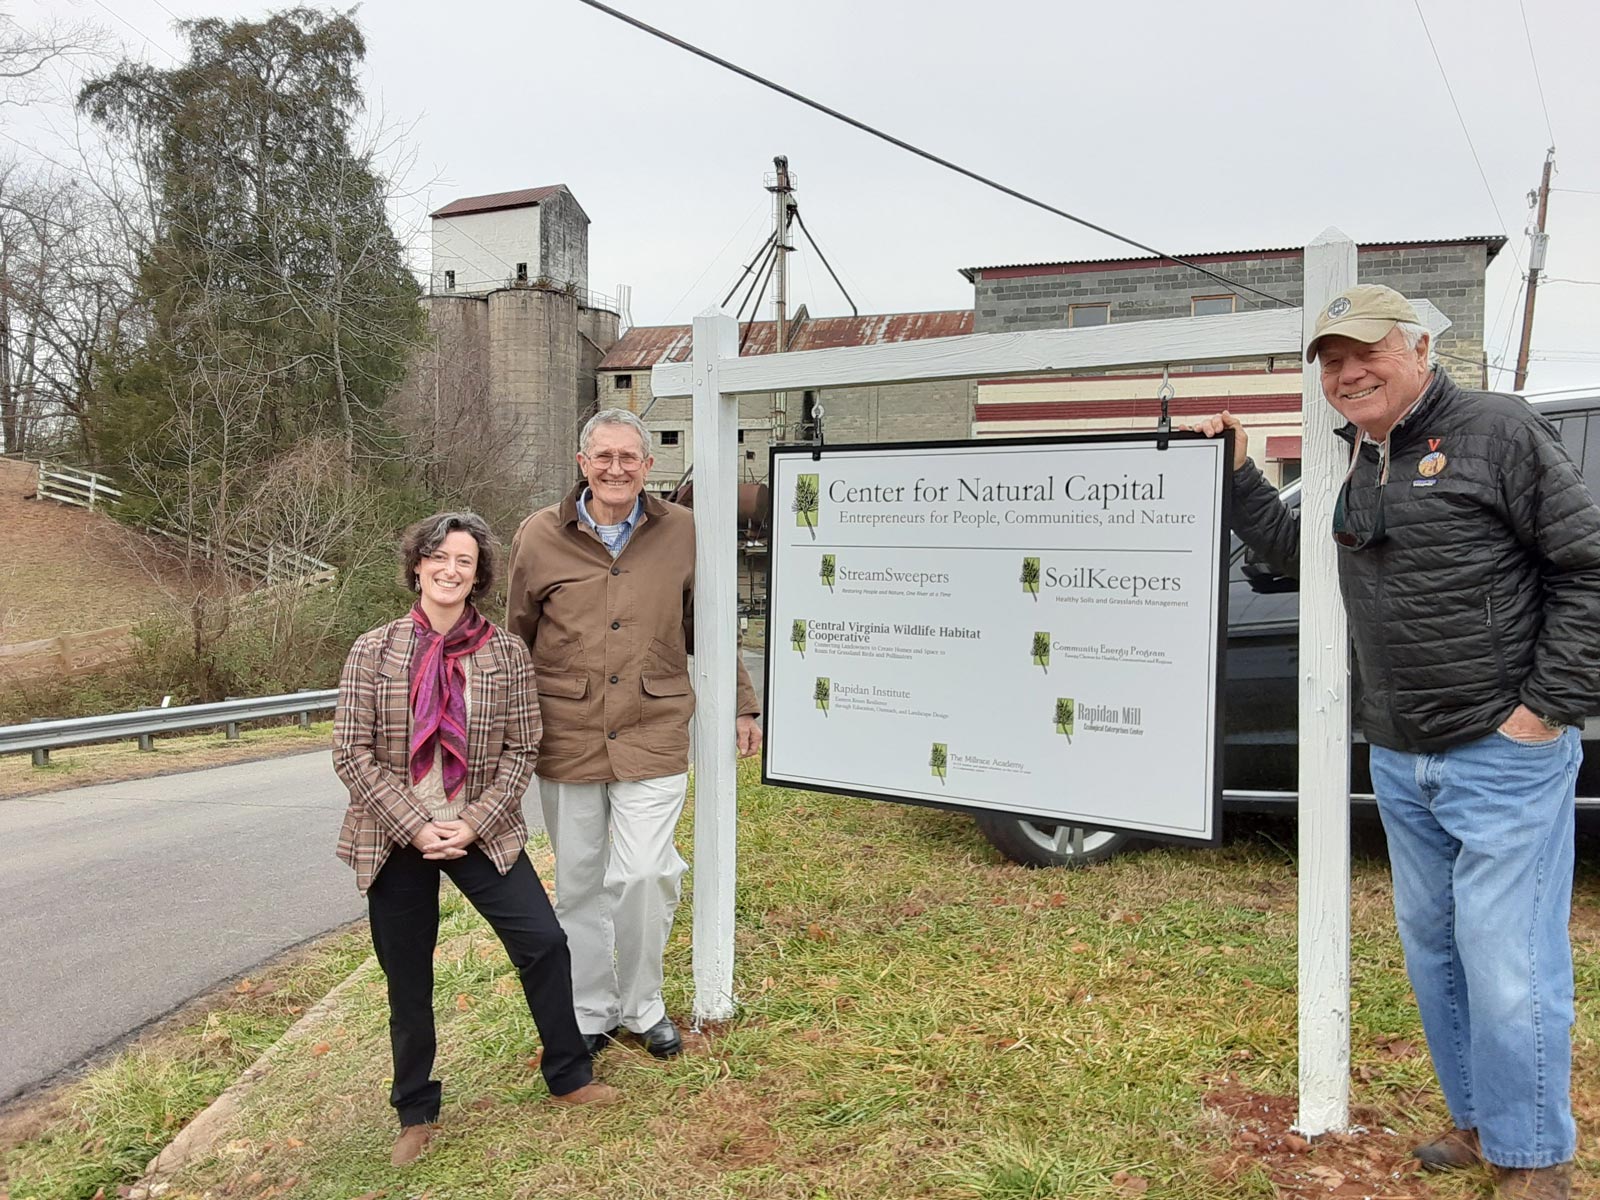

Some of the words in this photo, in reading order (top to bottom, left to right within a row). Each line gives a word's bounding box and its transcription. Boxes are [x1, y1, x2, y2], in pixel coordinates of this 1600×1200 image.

[828, 479, 905, 503] Center
[912, 477, 949, 503] for
[956, 475, 1054, 503] Natural
[1064, 473, 1165, 509] Capital
[839, 510, 925, 527] Entrepreneurs
[929, 510, 949, 524] for
[952, 510, 1000, 528] People,
[1004, 509, 1103, 527] Communities,
[1107, 509, 1135, 525] and
[1140, 509, 1196, 525] Nature
[839, 566, 949, 587] StreamSweepers
[1045, 566, 1182, 597] SoilKeepers
[1055, 596, 1079, 605] Healthy
[1080, 596, 1094, 604] Soils
[1109, 597, 1143, 606] Grasslands
[1144, 599, 1189, 608] Management
[808, 619, 845, 632] Central
[848, 621, 890, 634] Virginia
[893, 624, 936, 637] Wildlife
[939, 626, 982, 639] Habitat
[808, 629, 870, 643] Cooperative
[1053, 641, 1099, 655] Community
[1100, 644, 1129, 658] Energy
[1130, 645, 1165, 658] Program
[833, 682, 869, 696] Rapidan
[872, 685, 911, 699] Institute
[1078, 702, 1119, 725] Rapidan
[1122, 706, 1141, 726] Mill
[950, 753, 963, 761] The
[992, 758, 1025, 770] Academy
